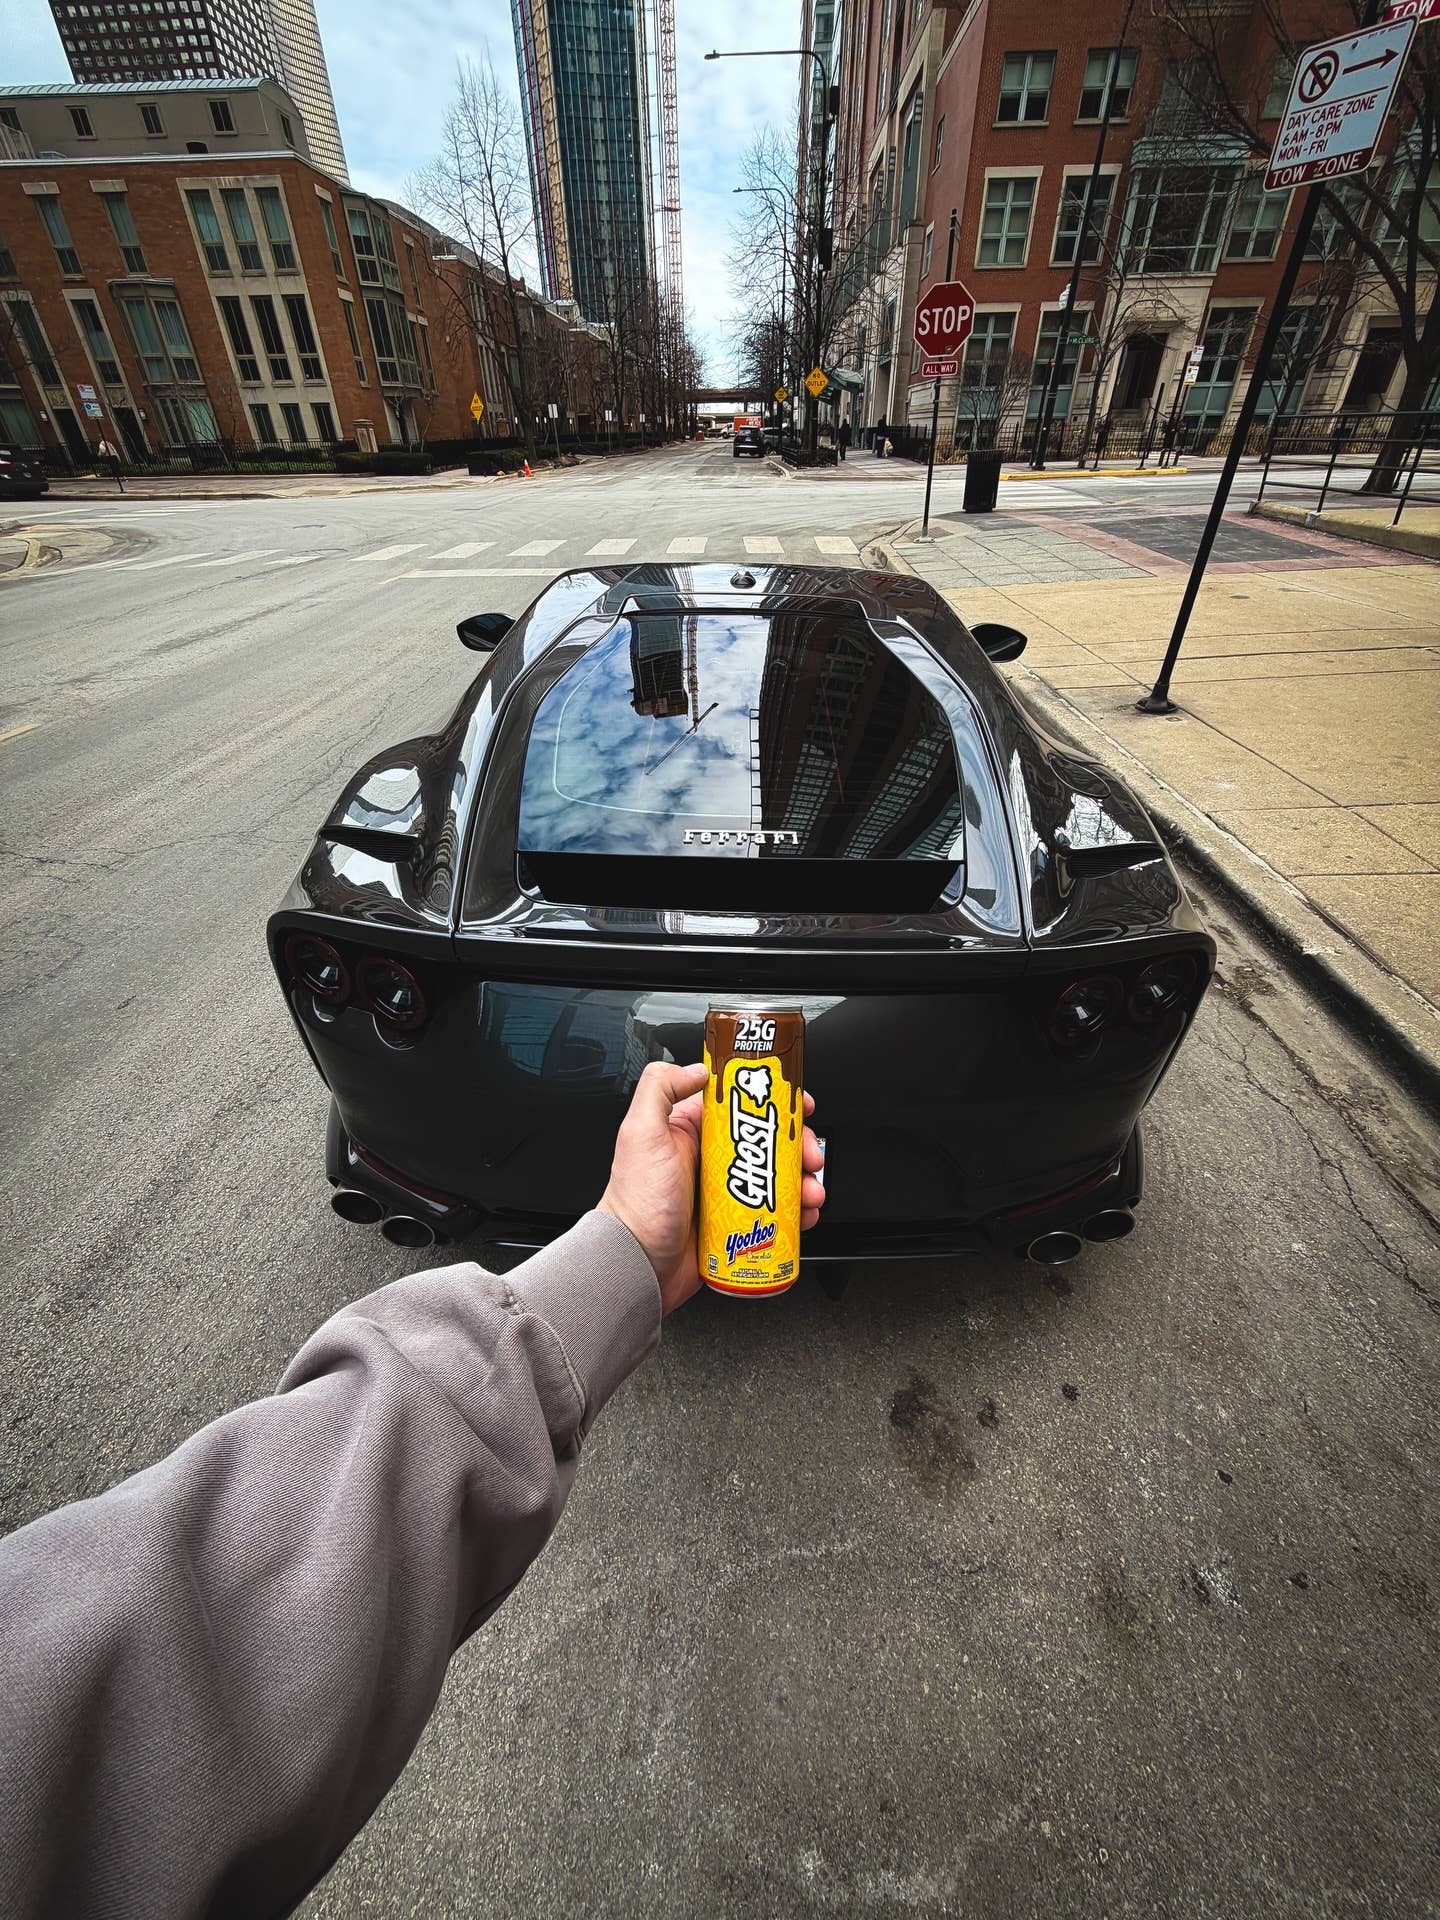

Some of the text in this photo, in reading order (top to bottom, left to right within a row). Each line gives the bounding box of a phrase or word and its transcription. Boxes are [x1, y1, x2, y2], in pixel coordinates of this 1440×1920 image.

[1287, 94, 1378, 131] DAY CARE ZONE
[1272, 151, 1363, 187] TOW ZONE
[917, 305, 971, 336] STOP
[925, 364, 954, 374] ALL WAY
[682, 829, 800, 845] Ferrari
[735, 1018, 776, 1041] 25G
[733, 1040, 773, 1051] PROTEIN
[728, 1088, 776, 1212] GHOST
